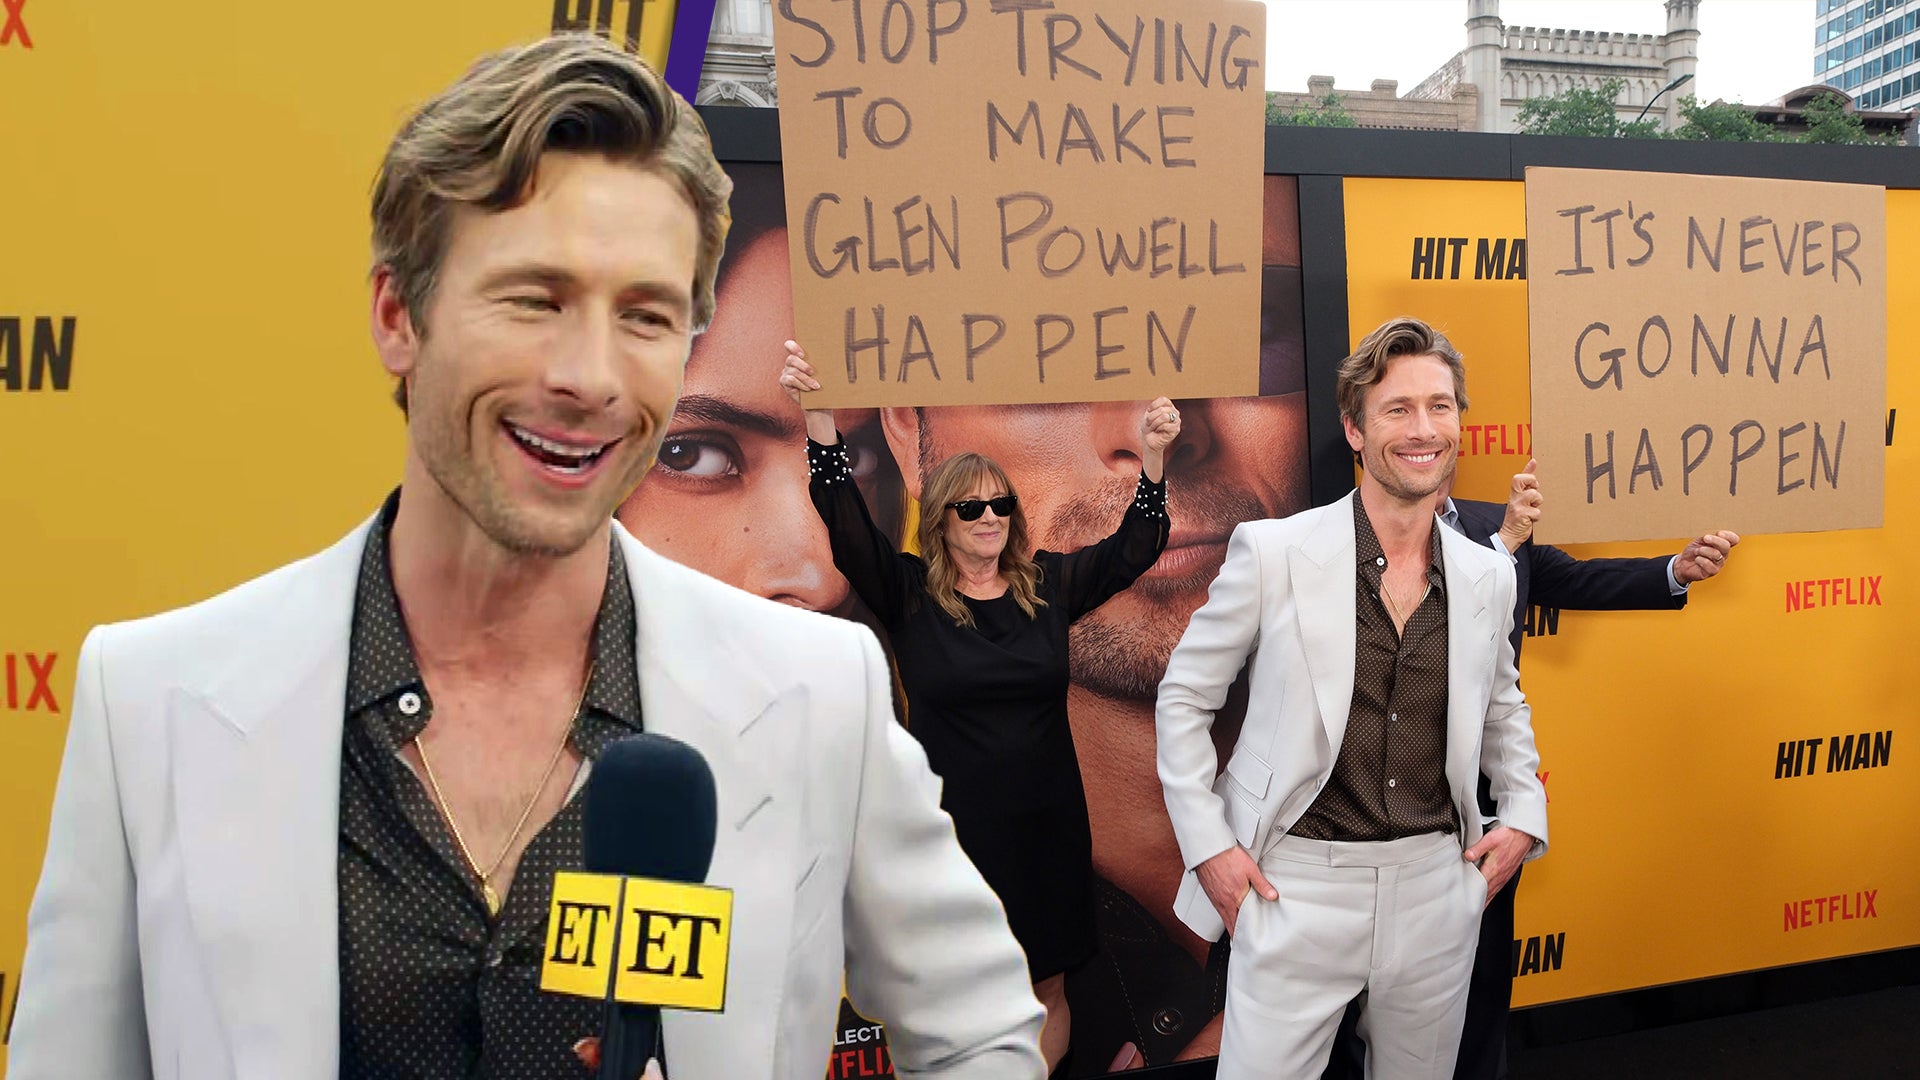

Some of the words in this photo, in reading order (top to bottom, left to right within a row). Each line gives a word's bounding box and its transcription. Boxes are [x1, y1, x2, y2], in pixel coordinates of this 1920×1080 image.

[779, 0, 967, 68] STOP
[990, 0, 1259, 92] TRYING
[814, 87, 912, 160] TO
[987, 101, 1197, 168] MAKE
[804, 192, 961, 279] GLEN
[996, 190, 1247, 279] POWELL
[1411, 237, 1469, 280] HIT
[1474, 238, 1527, 280] MA
[1555, 201, 1656, 276] IT'S
[1686, 215, 1862, 286] NEVER
[0, 316, 77, 391] AN
[843, 304, 1197, 384] HAPPEN
[1574, 313, 1831, 391] GONNA
[1584, 419, 1847, 504] HAPPEN
[1786, 575, 1882, 613] NETFLIX
[1775, 738, 1823, 779] HIT
[1826, 730, 1893, 773] MAN
[549, 900, 610, 967] ET
[627, 908, 720, 980] ET
[1784, 889, 1878, 932] NETFLIX
[1512, 932, 1566, 978] AN
[834, 1025, 884, 1046] LECT
